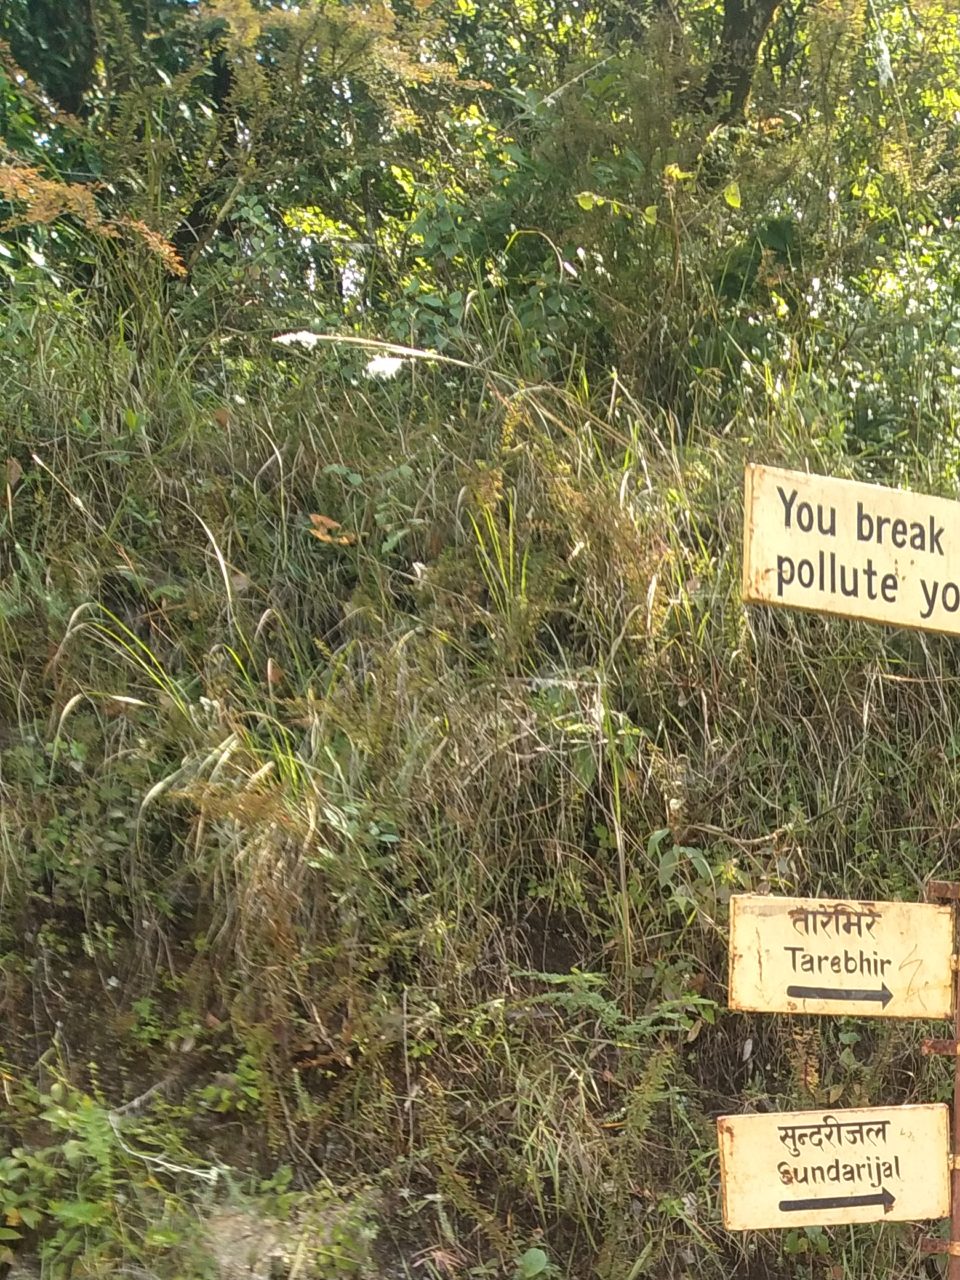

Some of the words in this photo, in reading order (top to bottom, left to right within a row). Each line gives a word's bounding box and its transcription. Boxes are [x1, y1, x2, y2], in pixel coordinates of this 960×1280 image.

[776, 486, 836, 536] You
[856, 502, 945, 555] break
[776, 550, 898, 602] pollute
[784, 946, 892, 977] Tarebhir
[778, 1115, 891, 1157] सुन्दरीजल
[777, 1155, 901, 1188] Sundarijal
